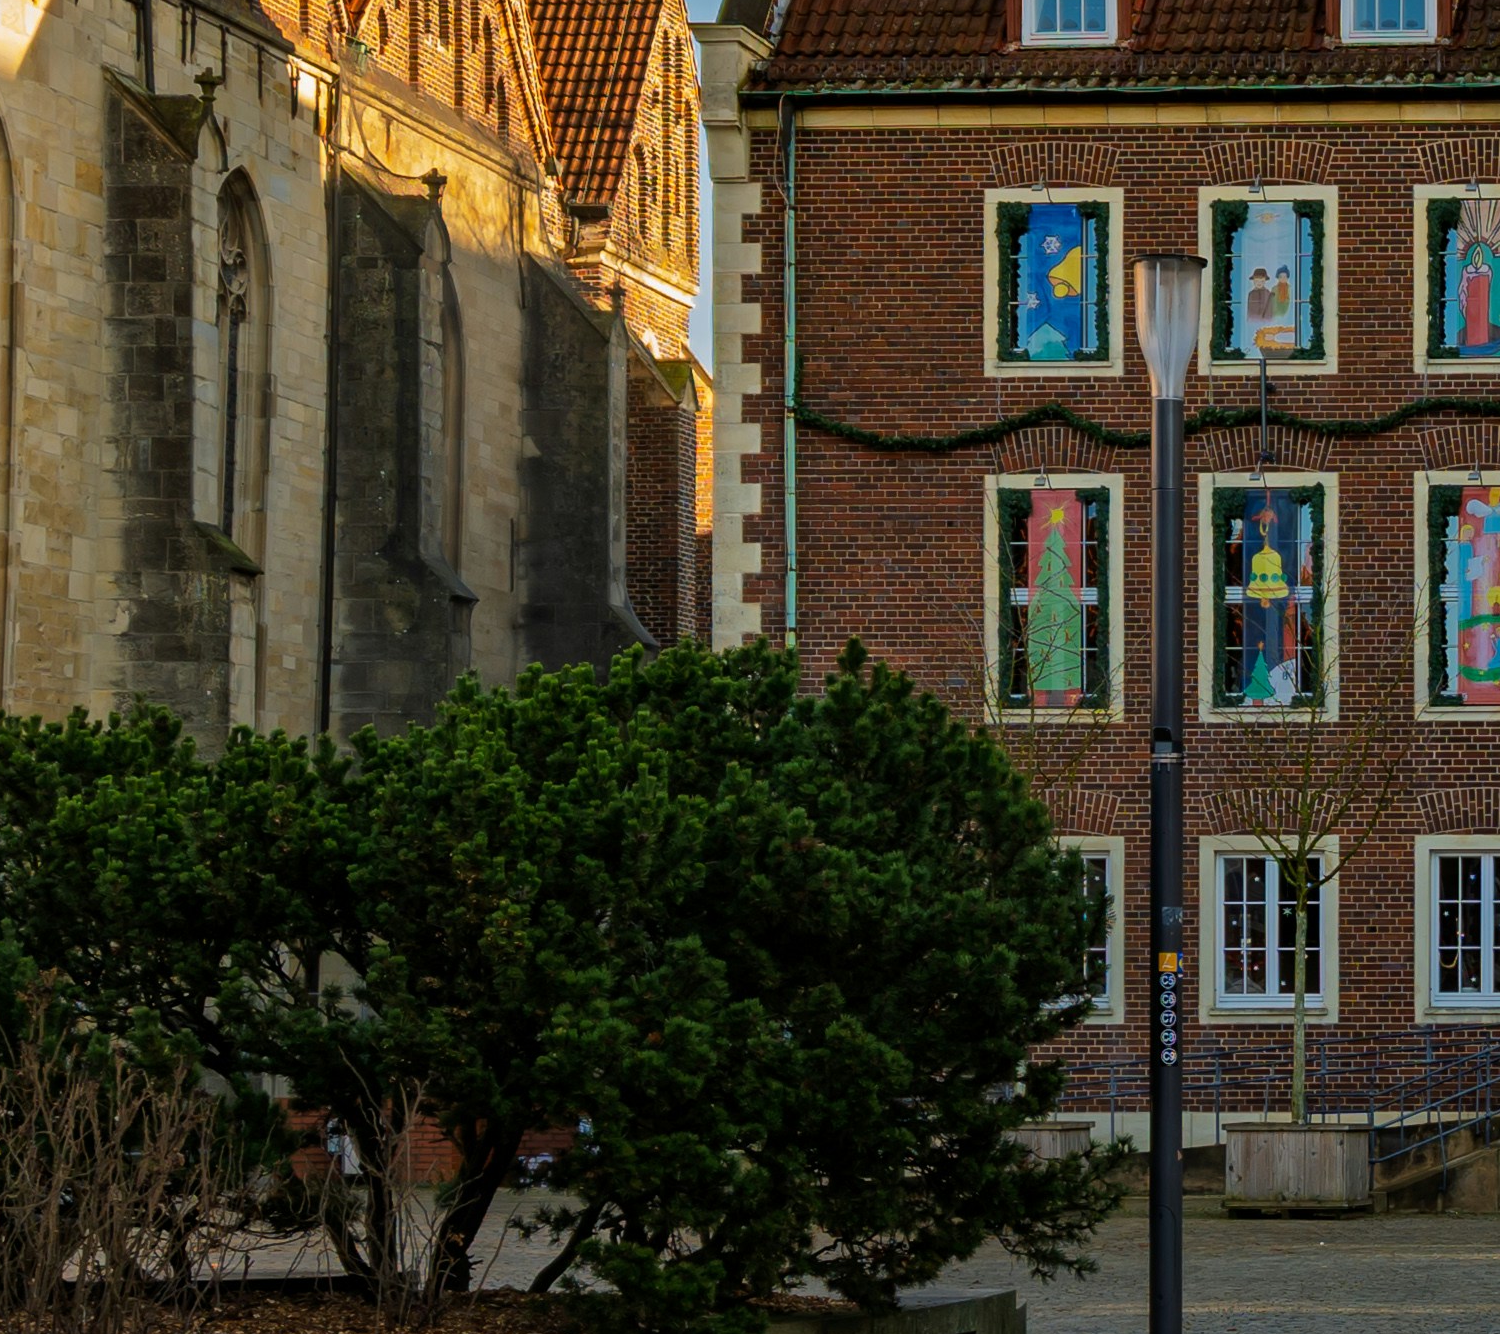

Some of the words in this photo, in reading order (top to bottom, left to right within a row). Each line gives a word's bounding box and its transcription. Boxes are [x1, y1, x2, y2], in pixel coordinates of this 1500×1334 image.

[1161, 975, 1175, 986] C5
[1162, 994, 1175, 1005] C6
[1162, 1013, 1175, 1024] C7
[1162, 1032, 1175, 1042] C8
[1162, 1051, 1176, 1061] C9
